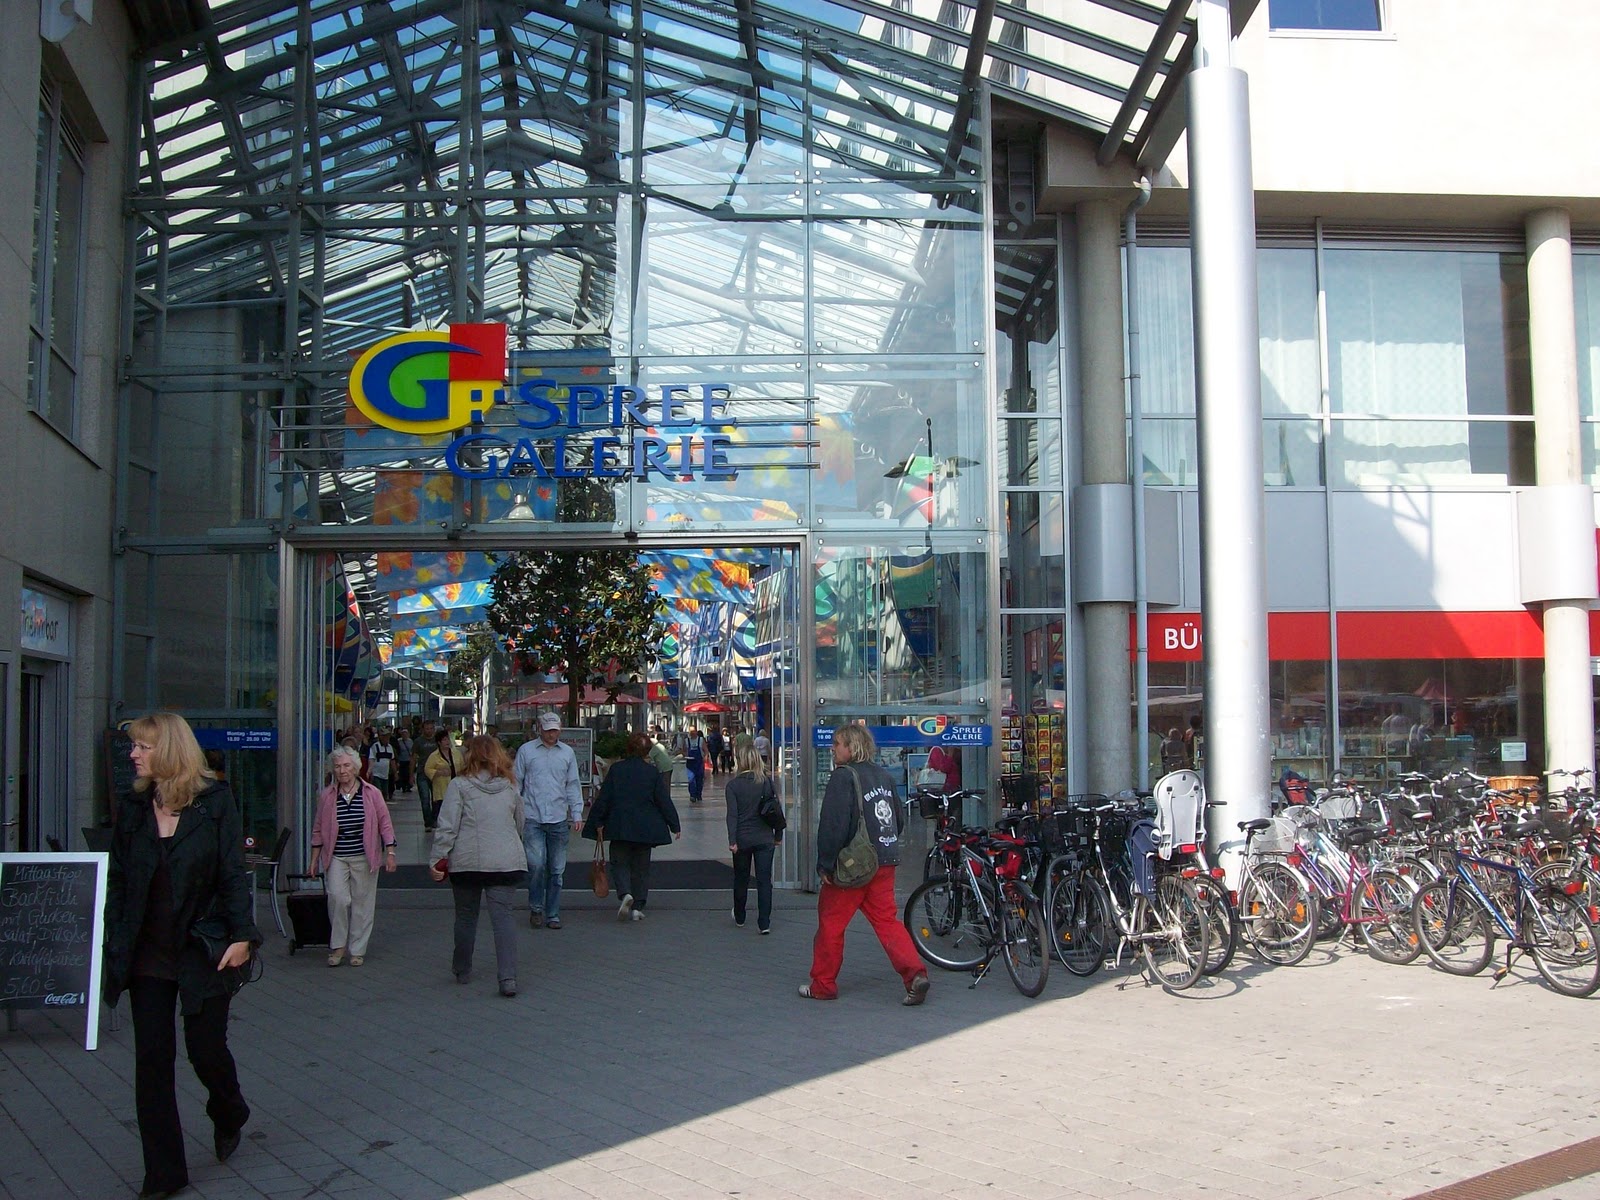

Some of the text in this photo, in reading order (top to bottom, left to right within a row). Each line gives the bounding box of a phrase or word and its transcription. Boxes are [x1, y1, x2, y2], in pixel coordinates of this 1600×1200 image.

[517, 379, 737, 429] SPREE
[445, 432, 740, 482] GALERIE
[1164, 622, 1202, 650] BÜ
[952, 726, 983, 734] SPREE
